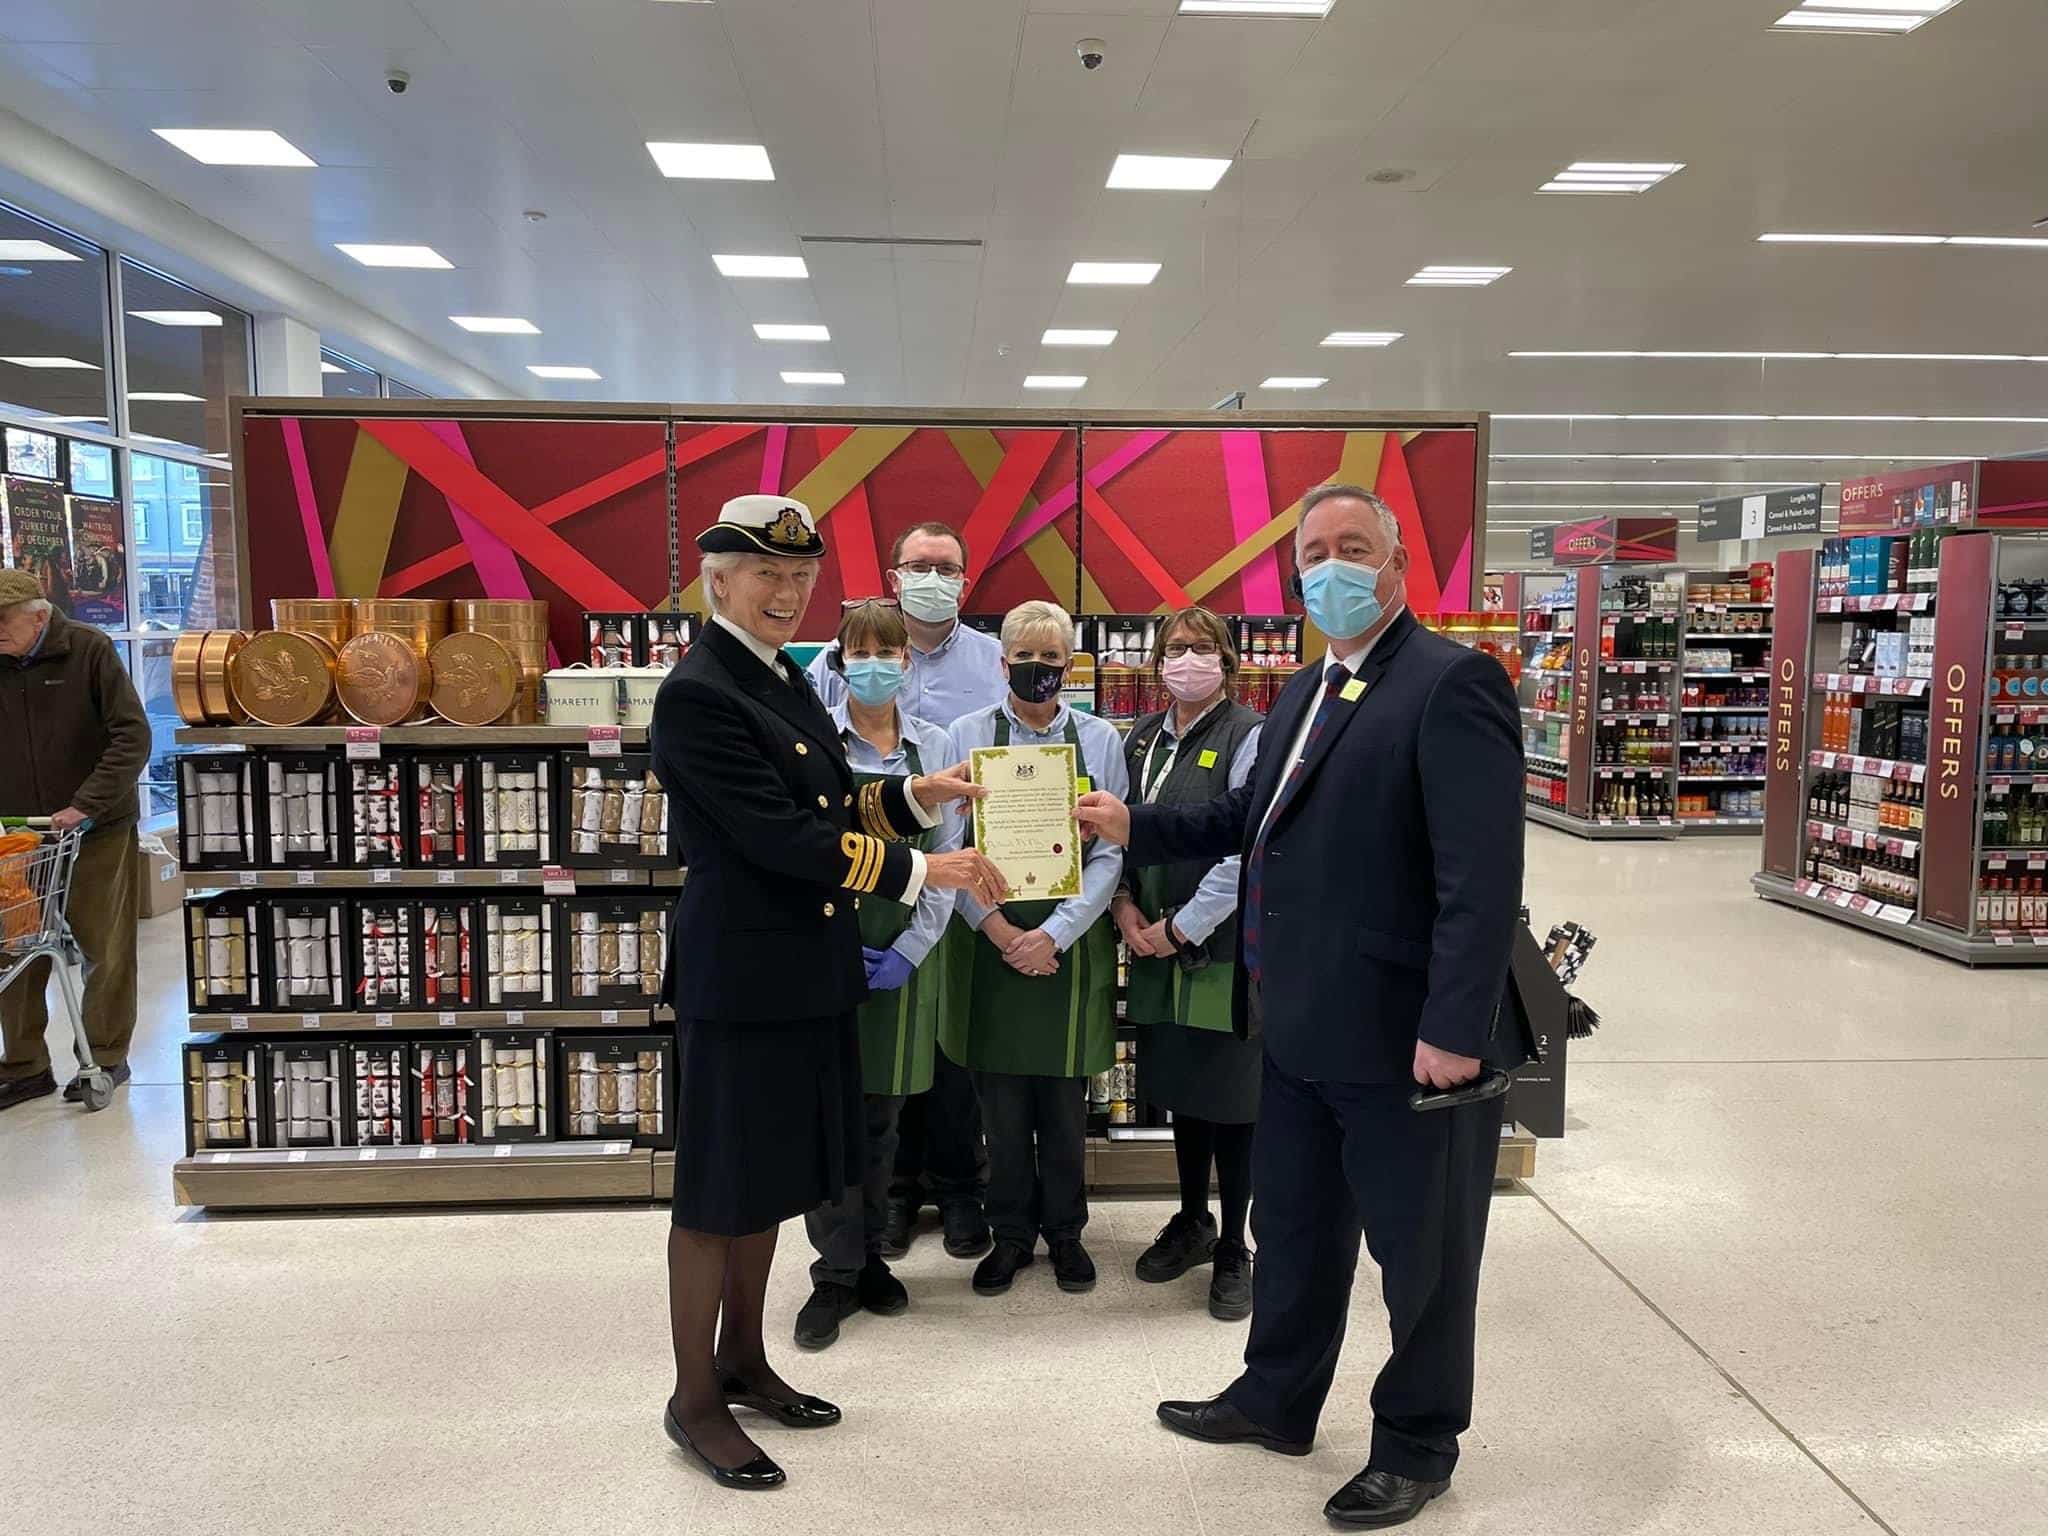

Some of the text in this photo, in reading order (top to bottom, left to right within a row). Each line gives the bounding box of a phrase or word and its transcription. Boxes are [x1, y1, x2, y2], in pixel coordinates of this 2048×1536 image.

[1842, 484, 1884, 502] OFFERS
[14, 506, 63, 521] ORDER YOUR
[1751, 510, 1757, 525] 3
[20, 520, 60, 534] TURKEY BY
[27, 535, 64, 546] DECEMBER
[1568, 535, 1596, 551] OFFERS
[1576, 648, 1590, 736] OFFERS
[548, 698, 599, 706] AMARETTI
[628, 698, 656, 706] AMAR
[1776, 658, 1795, 771] OFFERS
[1940, 664, 1966, 800] OFFERS
[1540, 1034, 1548, 1045] 2
